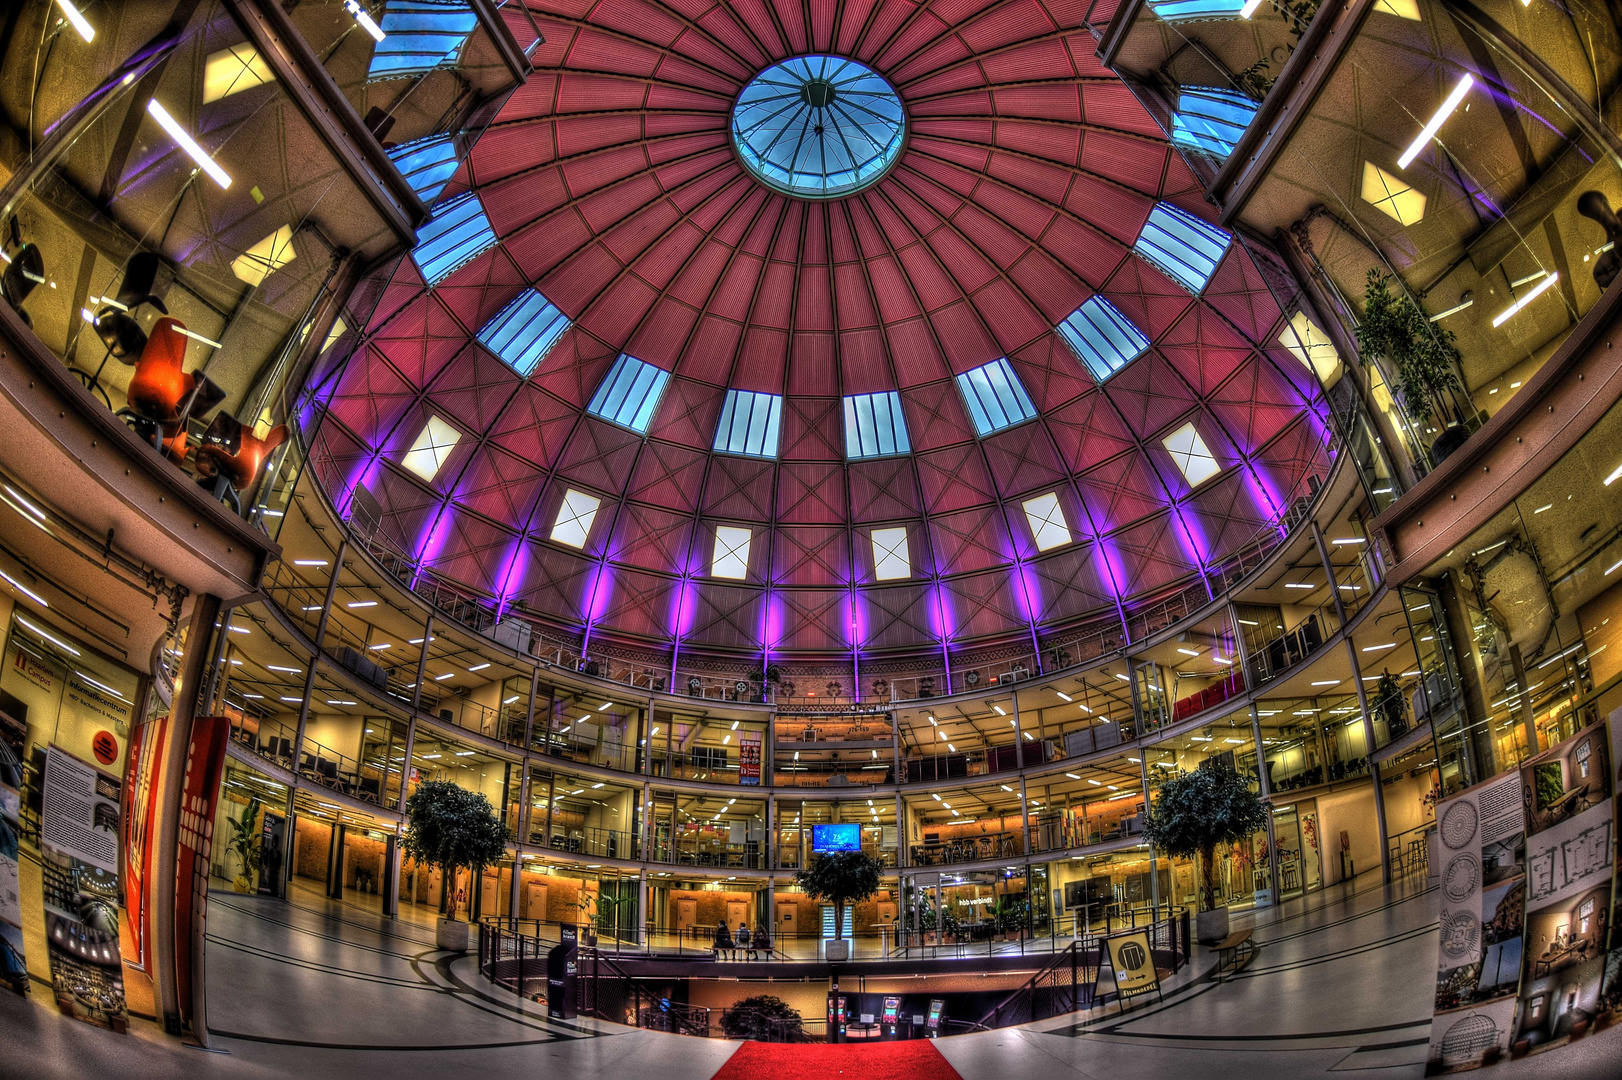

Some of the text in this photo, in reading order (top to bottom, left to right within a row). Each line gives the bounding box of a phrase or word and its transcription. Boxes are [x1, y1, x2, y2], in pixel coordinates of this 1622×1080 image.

[27, 667, 51, 687] Campus
[30, 657, 54, 677] Haarlem
[69, 680, 127, 716] Informatiecentrum
[80, 698, 102, 714] Bachelors
[106, 711, 124, 725] Masters
[970, 896, 993, 905] verbindt
